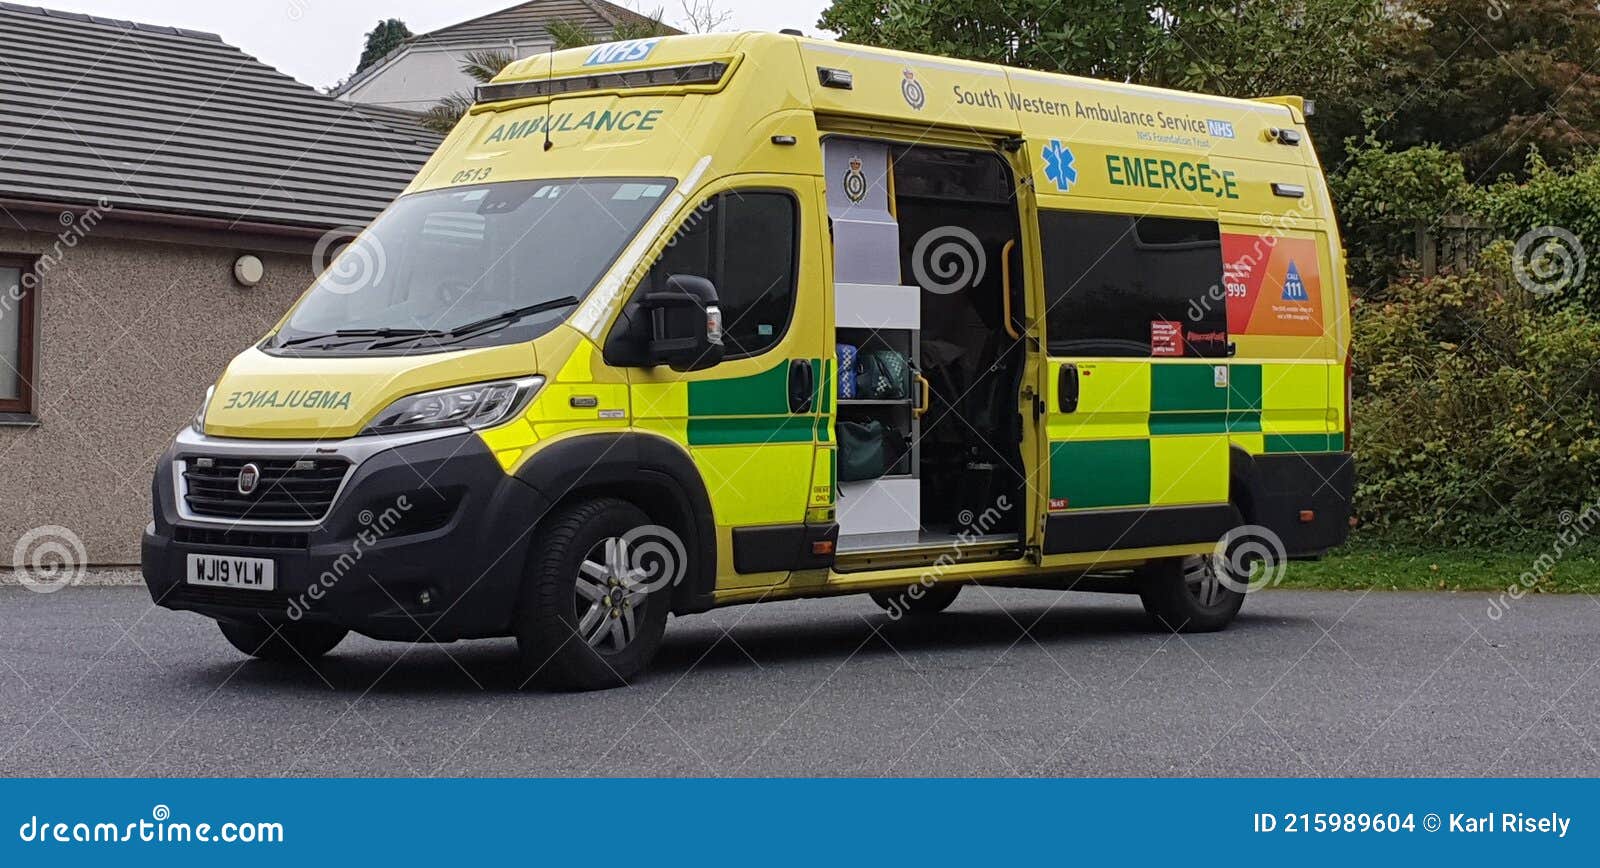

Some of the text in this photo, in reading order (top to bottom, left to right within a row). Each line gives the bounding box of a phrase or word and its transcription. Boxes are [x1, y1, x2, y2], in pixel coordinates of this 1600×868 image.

[584, 40, 658, 65] NHS
[953, 85, 1234, 138] South Western Ambulance Service NHS
[484, 110, 663, 144] AMBULANCE
[451, 167, 492, 184] 0513
[1227, 283, 1247, 297] 999
[1285, 282, 1302, 297] 111
[197, 558, 263, 585] WJ19 YLW
